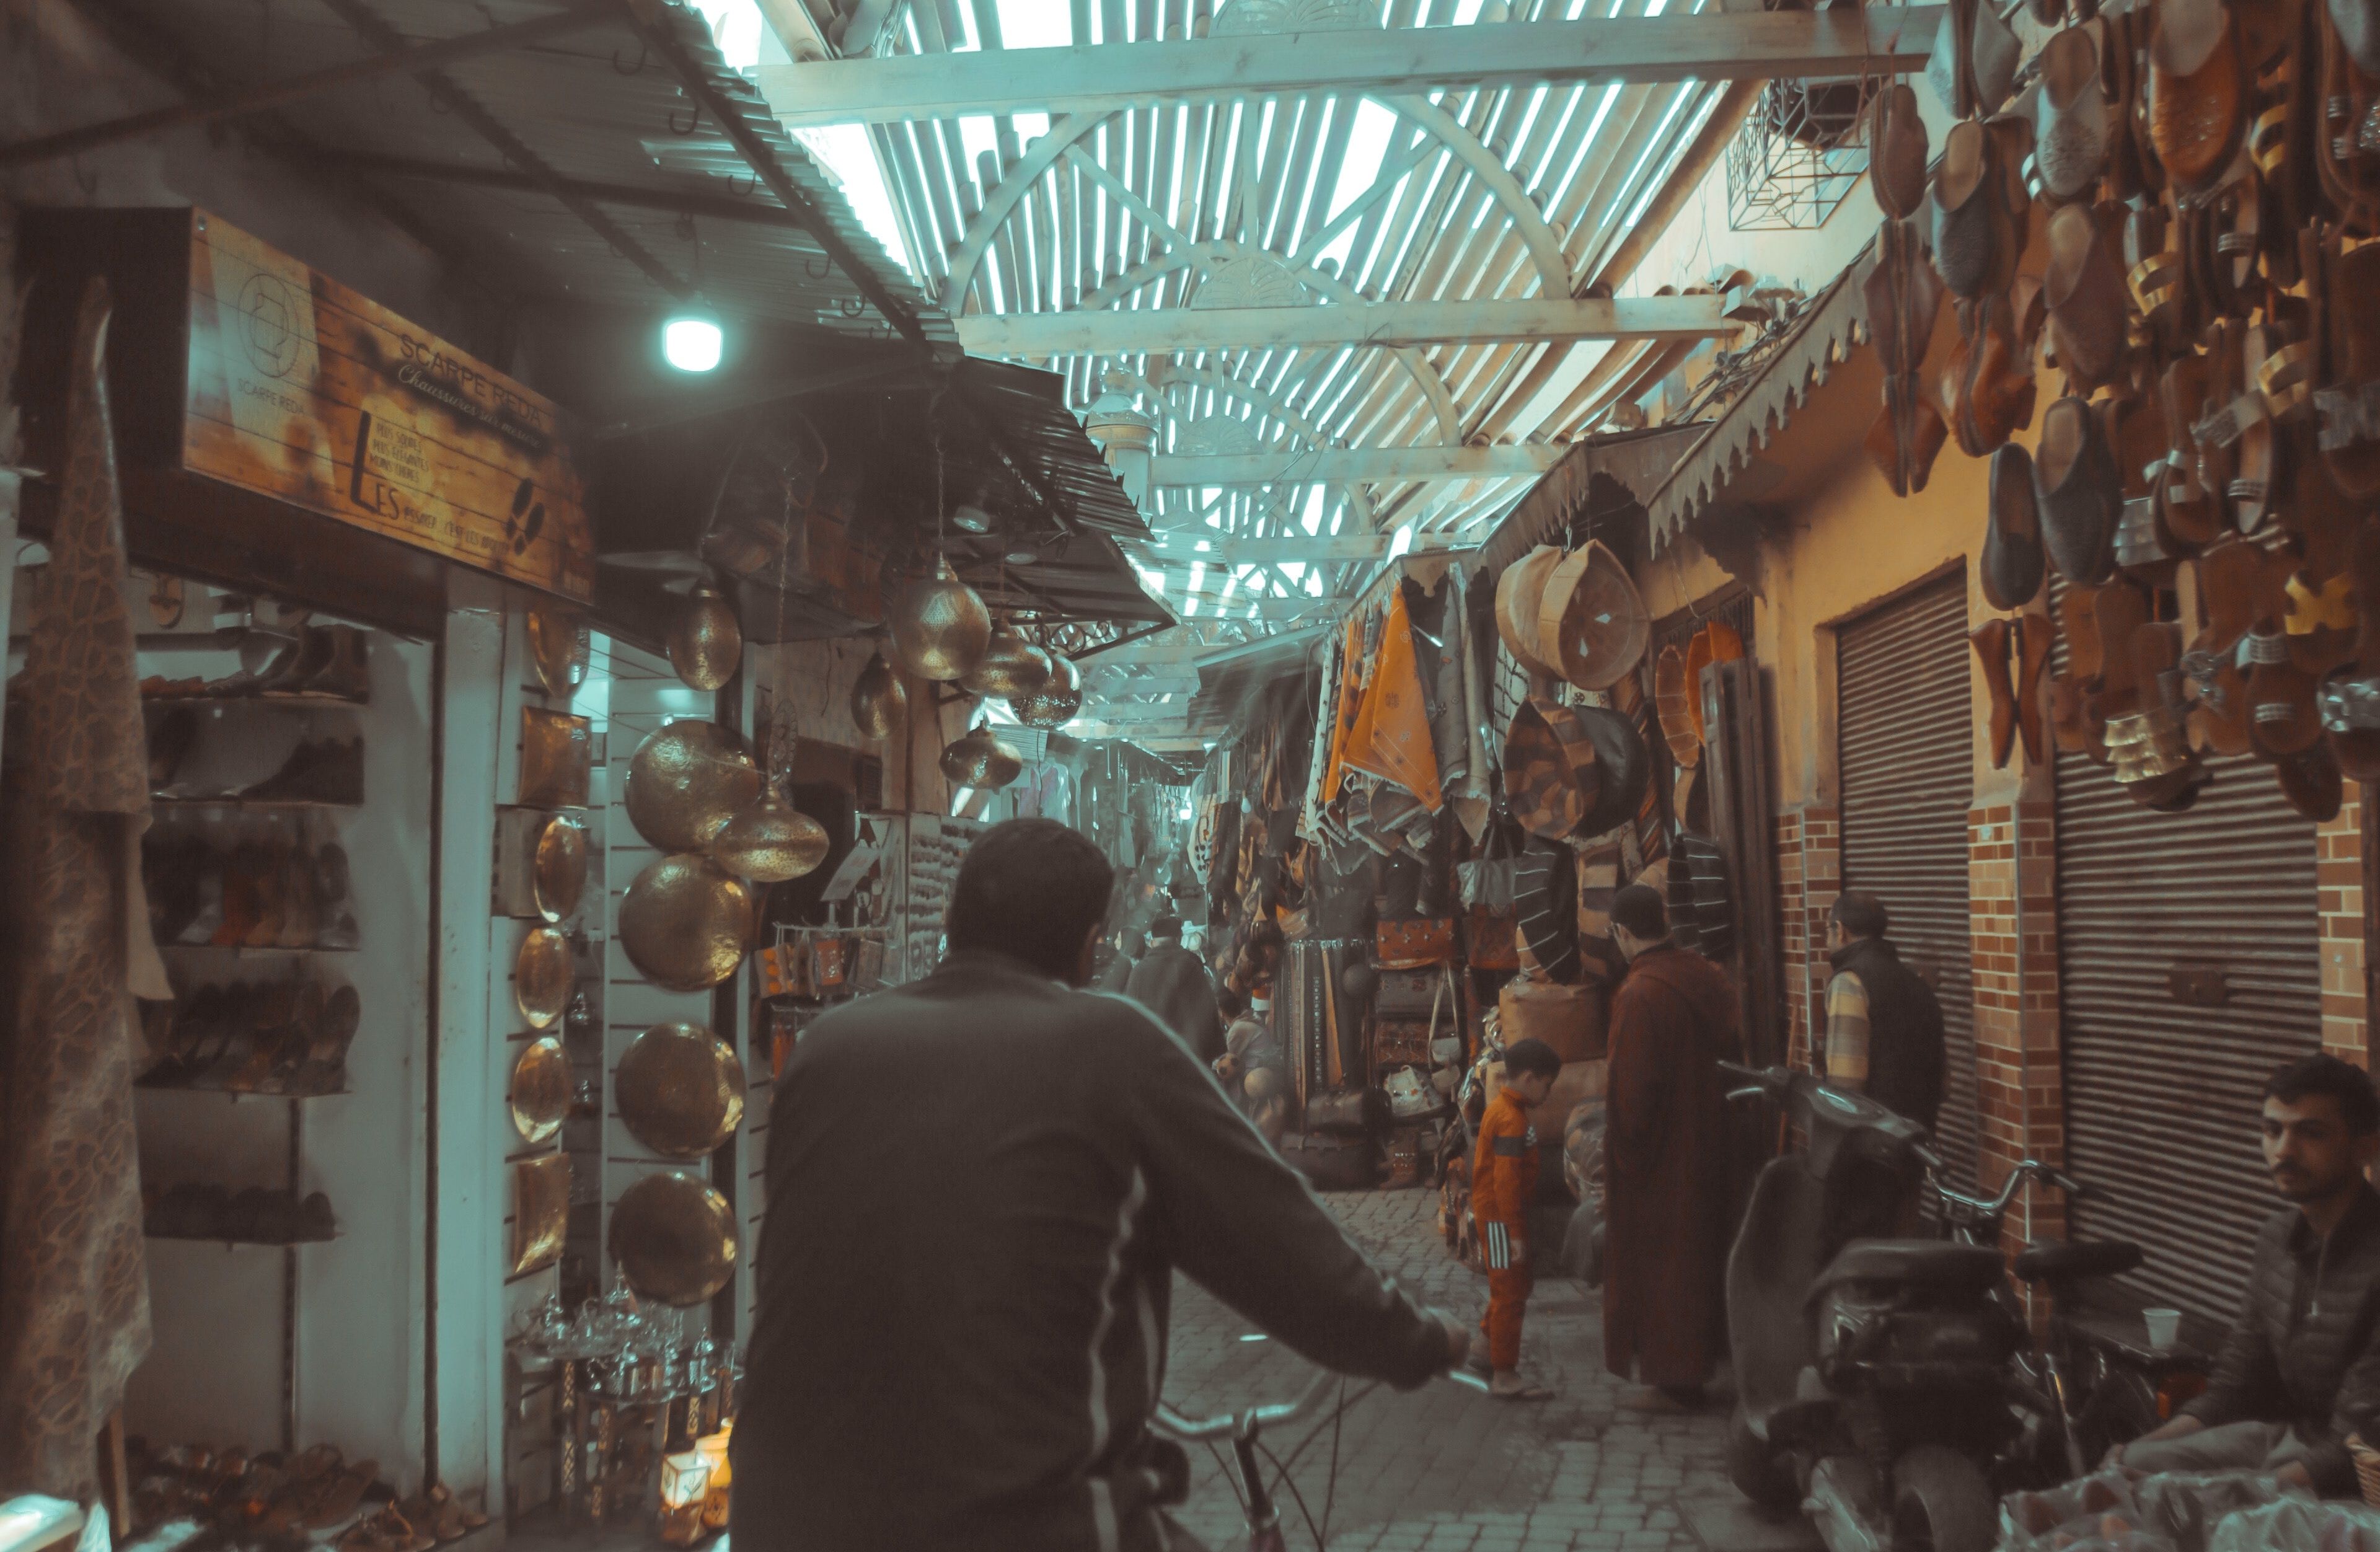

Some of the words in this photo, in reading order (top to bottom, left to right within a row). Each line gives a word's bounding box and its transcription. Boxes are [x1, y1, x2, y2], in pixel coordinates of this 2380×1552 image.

[237, 377, 277, 407] SCARPE
[279, 394, 304, 415] REDA
[398, 364, 477, 417] Chaussures
[501, 423, 543, 449] mesure
[400, 333, 487, 397] SCARPE
[493, 385, 540, 426] REDA
